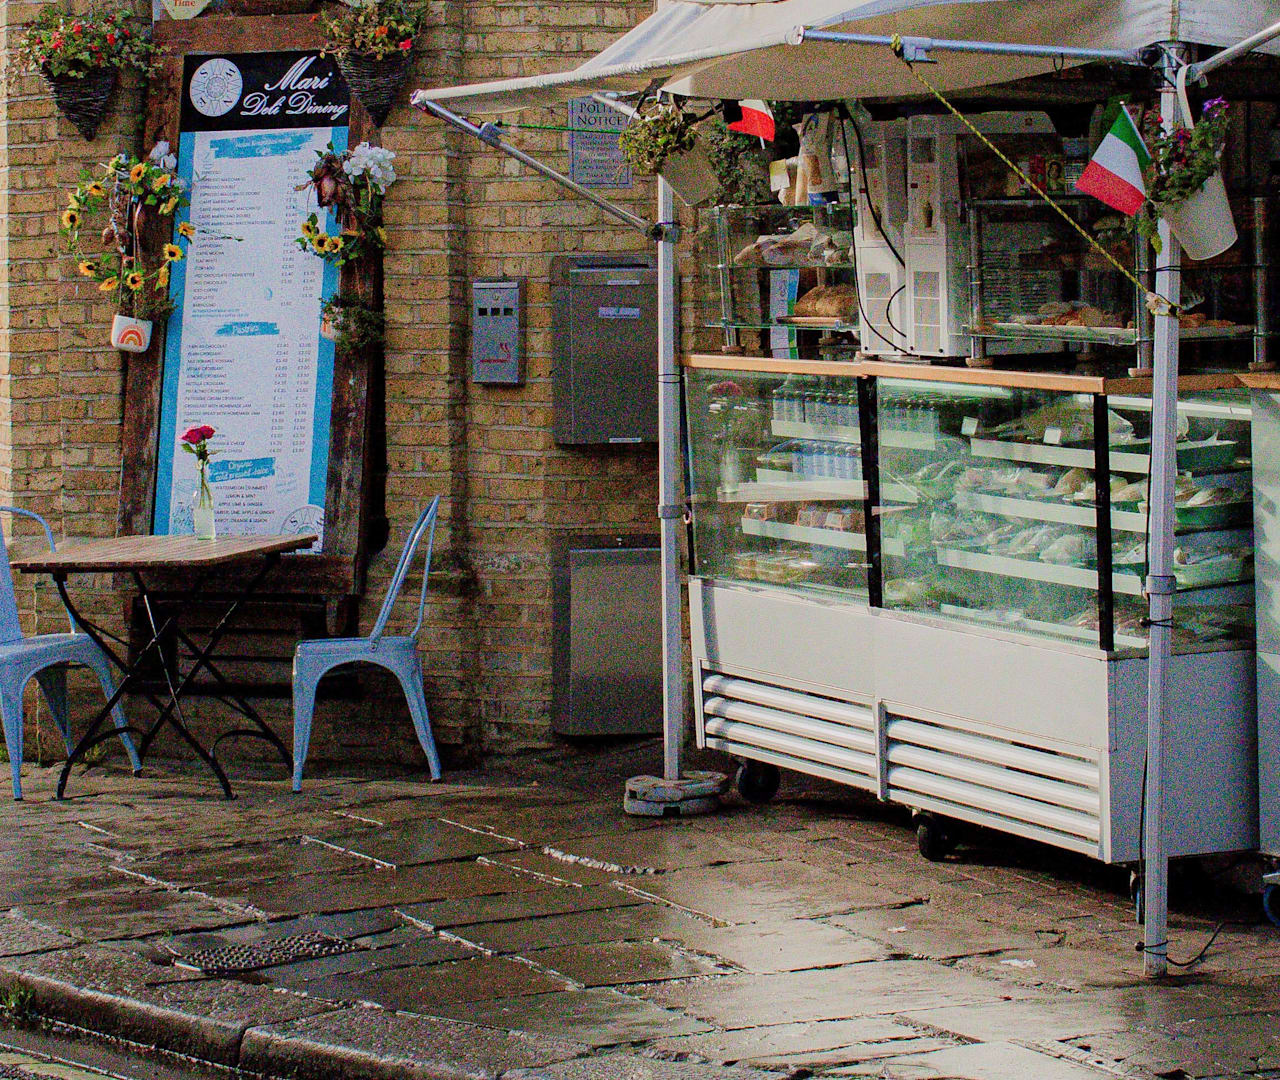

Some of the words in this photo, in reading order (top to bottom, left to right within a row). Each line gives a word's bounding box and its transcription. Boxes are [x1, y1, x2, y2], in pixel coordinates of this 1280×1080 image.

[174, 0, 196, 7] Time
[264, 56, 332, 92] Mari
[240, 92, 286, 116] Deli
[286, 91, 348, 121] Dining
[578, 116, 622, 126] NOTICE
